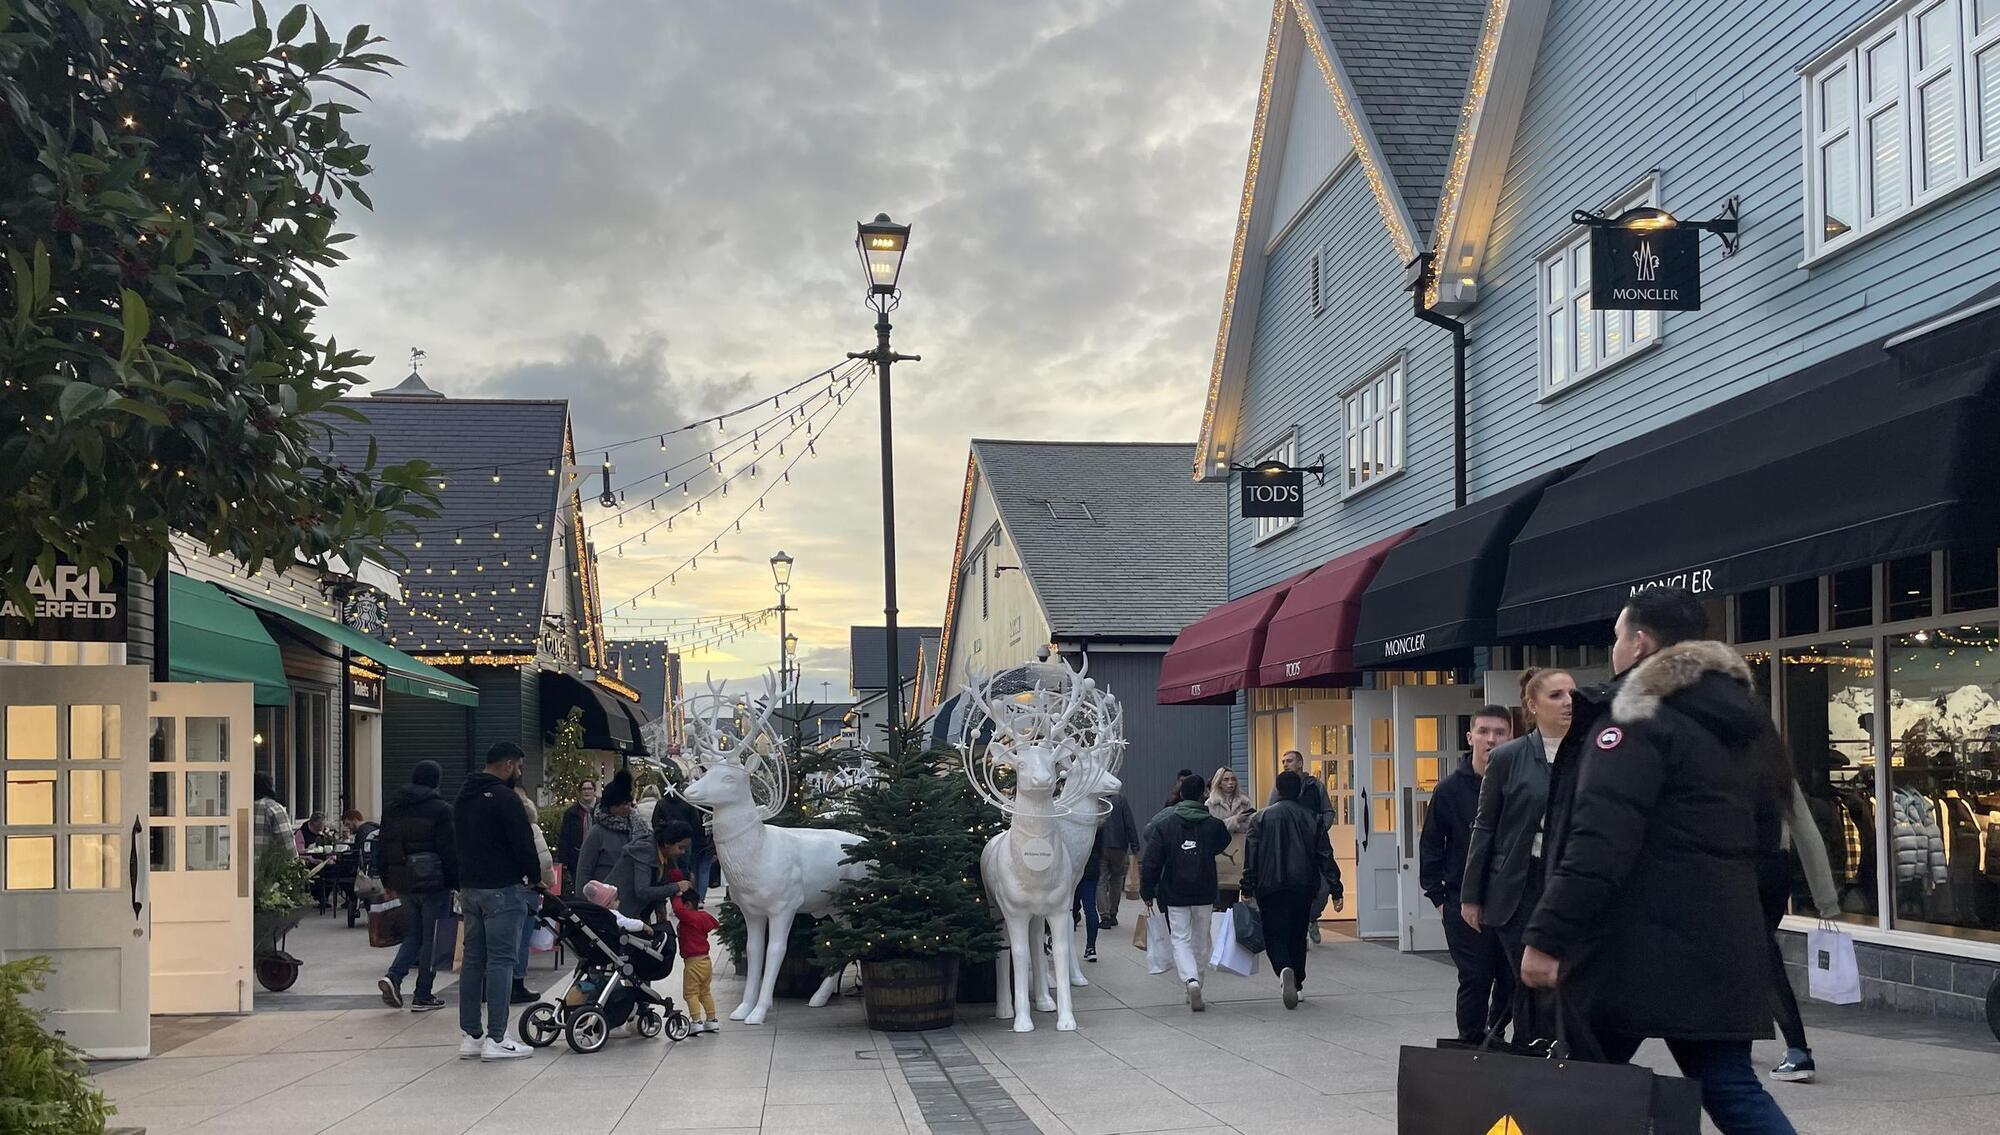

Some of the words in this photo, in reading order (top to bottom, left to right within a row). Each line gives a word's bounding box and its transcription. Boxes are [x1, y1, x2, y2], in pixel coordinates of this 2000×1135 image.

[1613, 289, 1679, 300] MONCLER
[1246, 485, 1299, 502] TOD'S
[26, 565, 117, 601] ARL
[1385, 633, 1426, 657] MONCLER
